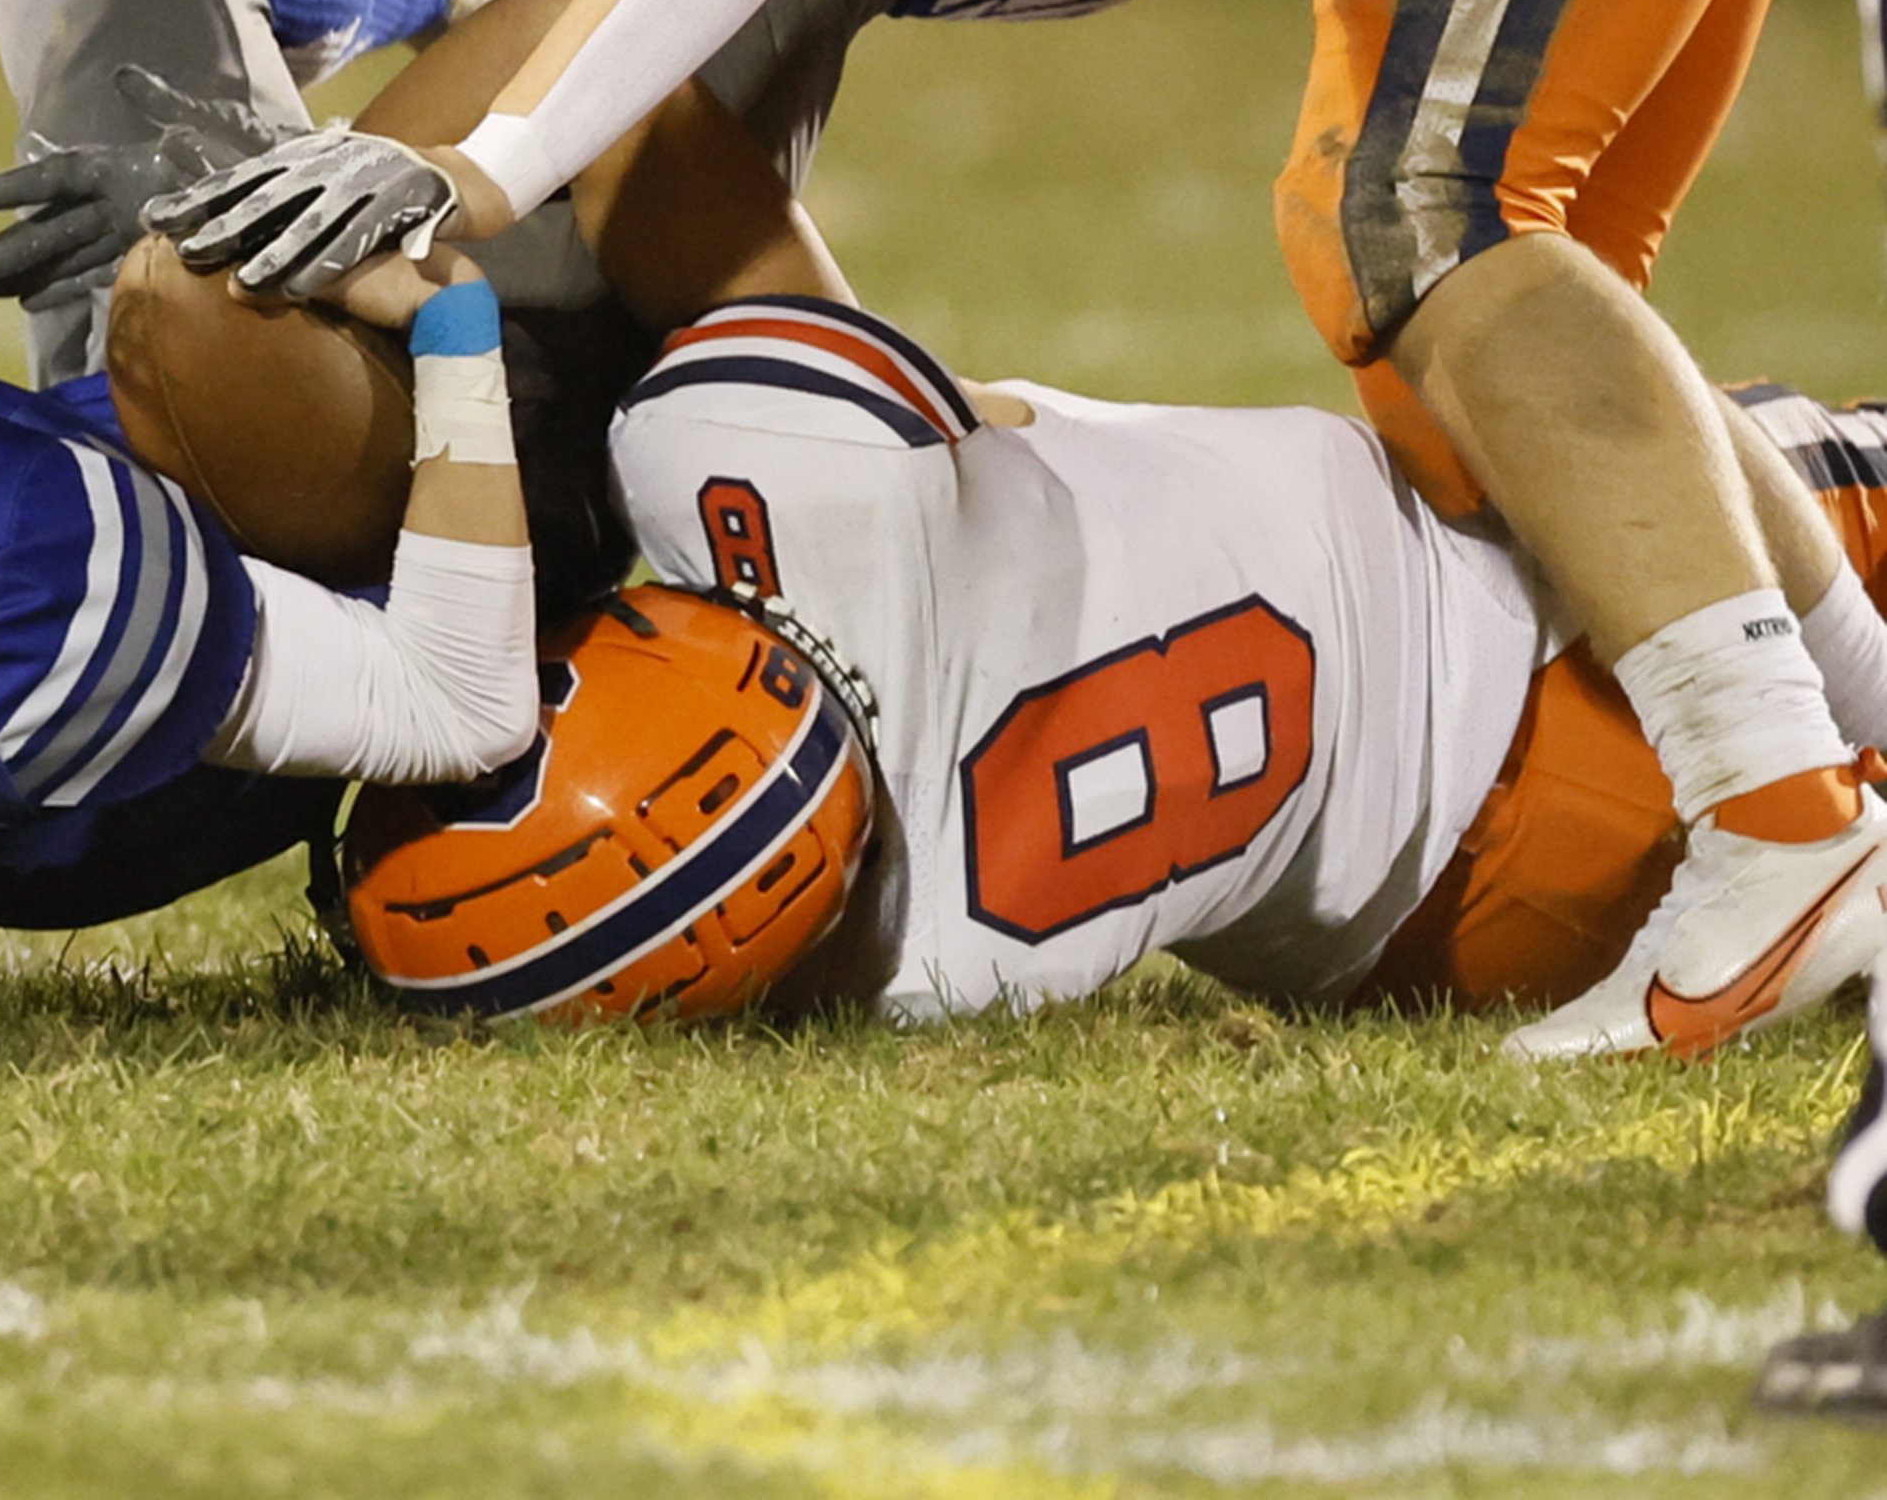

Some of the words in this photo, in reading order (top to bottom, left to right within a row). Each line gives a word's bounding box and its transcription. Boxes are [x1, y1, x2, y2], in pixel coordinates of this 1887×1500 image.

[696, 474, 785, 601] 8
[759, 645, 816, 711] 8
[960, 592, 1317, 947] 8
